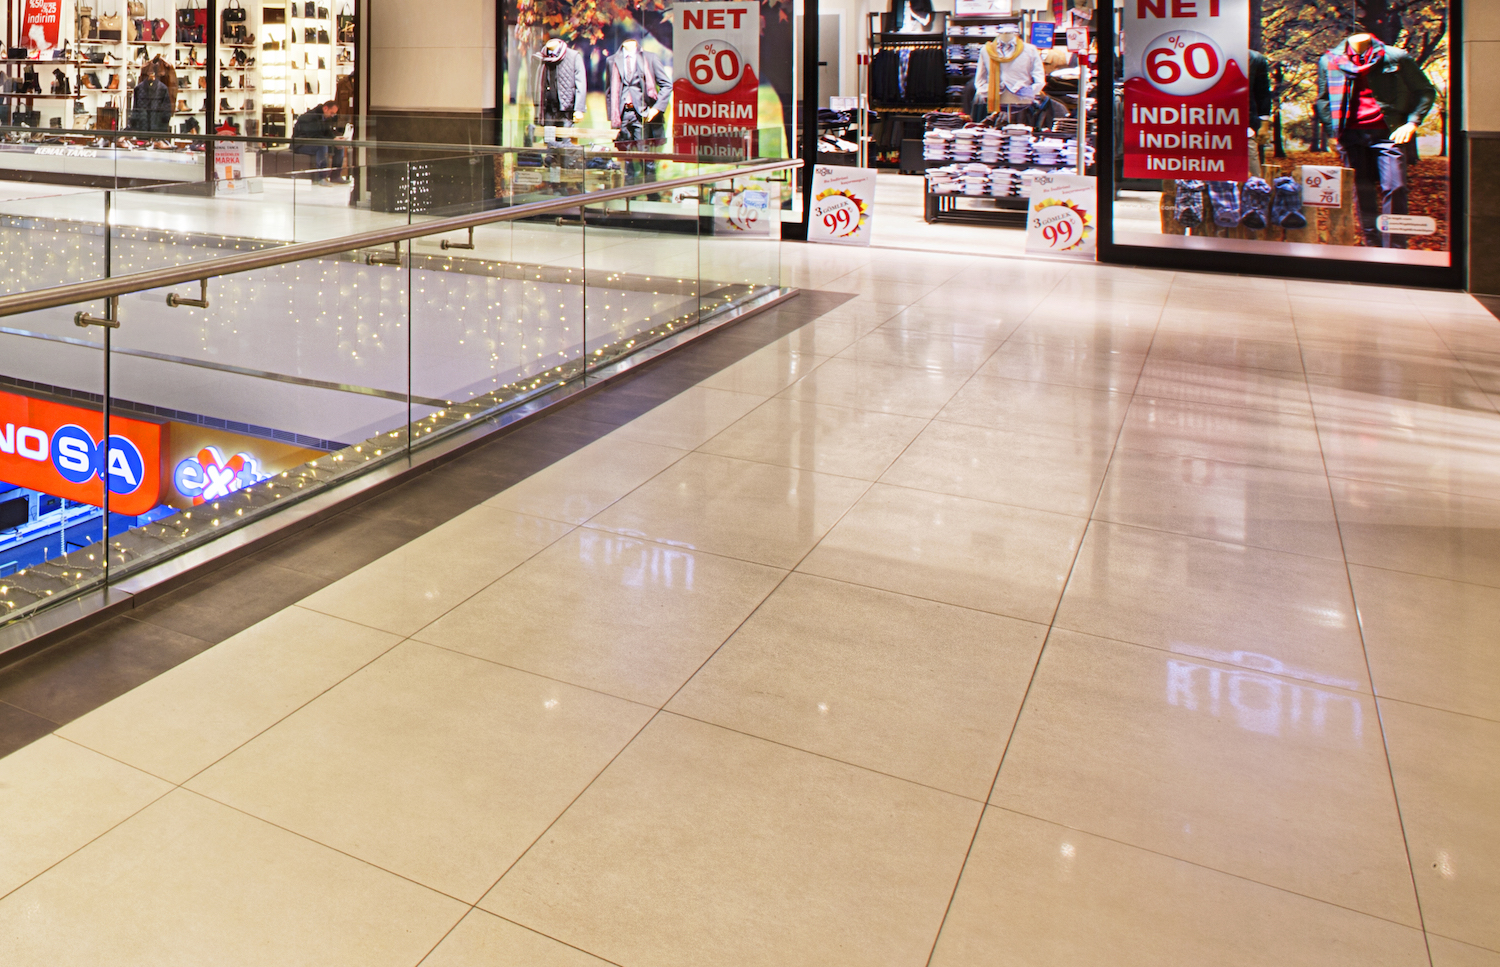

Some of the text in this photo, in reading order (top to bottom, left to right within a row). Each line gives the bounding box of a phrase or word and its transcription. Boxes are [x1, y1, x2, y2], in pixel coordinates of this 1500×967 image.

[27, 13, 56, 23] indirim
[683, 9, 747, 30] NET
[689, 49, 740, 85] 60
[1146, 42, 1219, 85] 60
[678, 99, 753, 119] İNDİRİM
[1131, 103, 1240, 125] İNDİRİM
[683, 123, 748, 138] İNDİRİM
[1139, 130, 1232, 150] İNDİRİM
[35, 147, 97, 158] KEMAL TANCA
[1147, 155, 1225, 172] İNDİRİM
[815, 206, 823, 217] 3
[823, 208, 850, 235] 99
[1033, 218, 1041, 229] 3
[1042, 220, 1072, 248] 99
